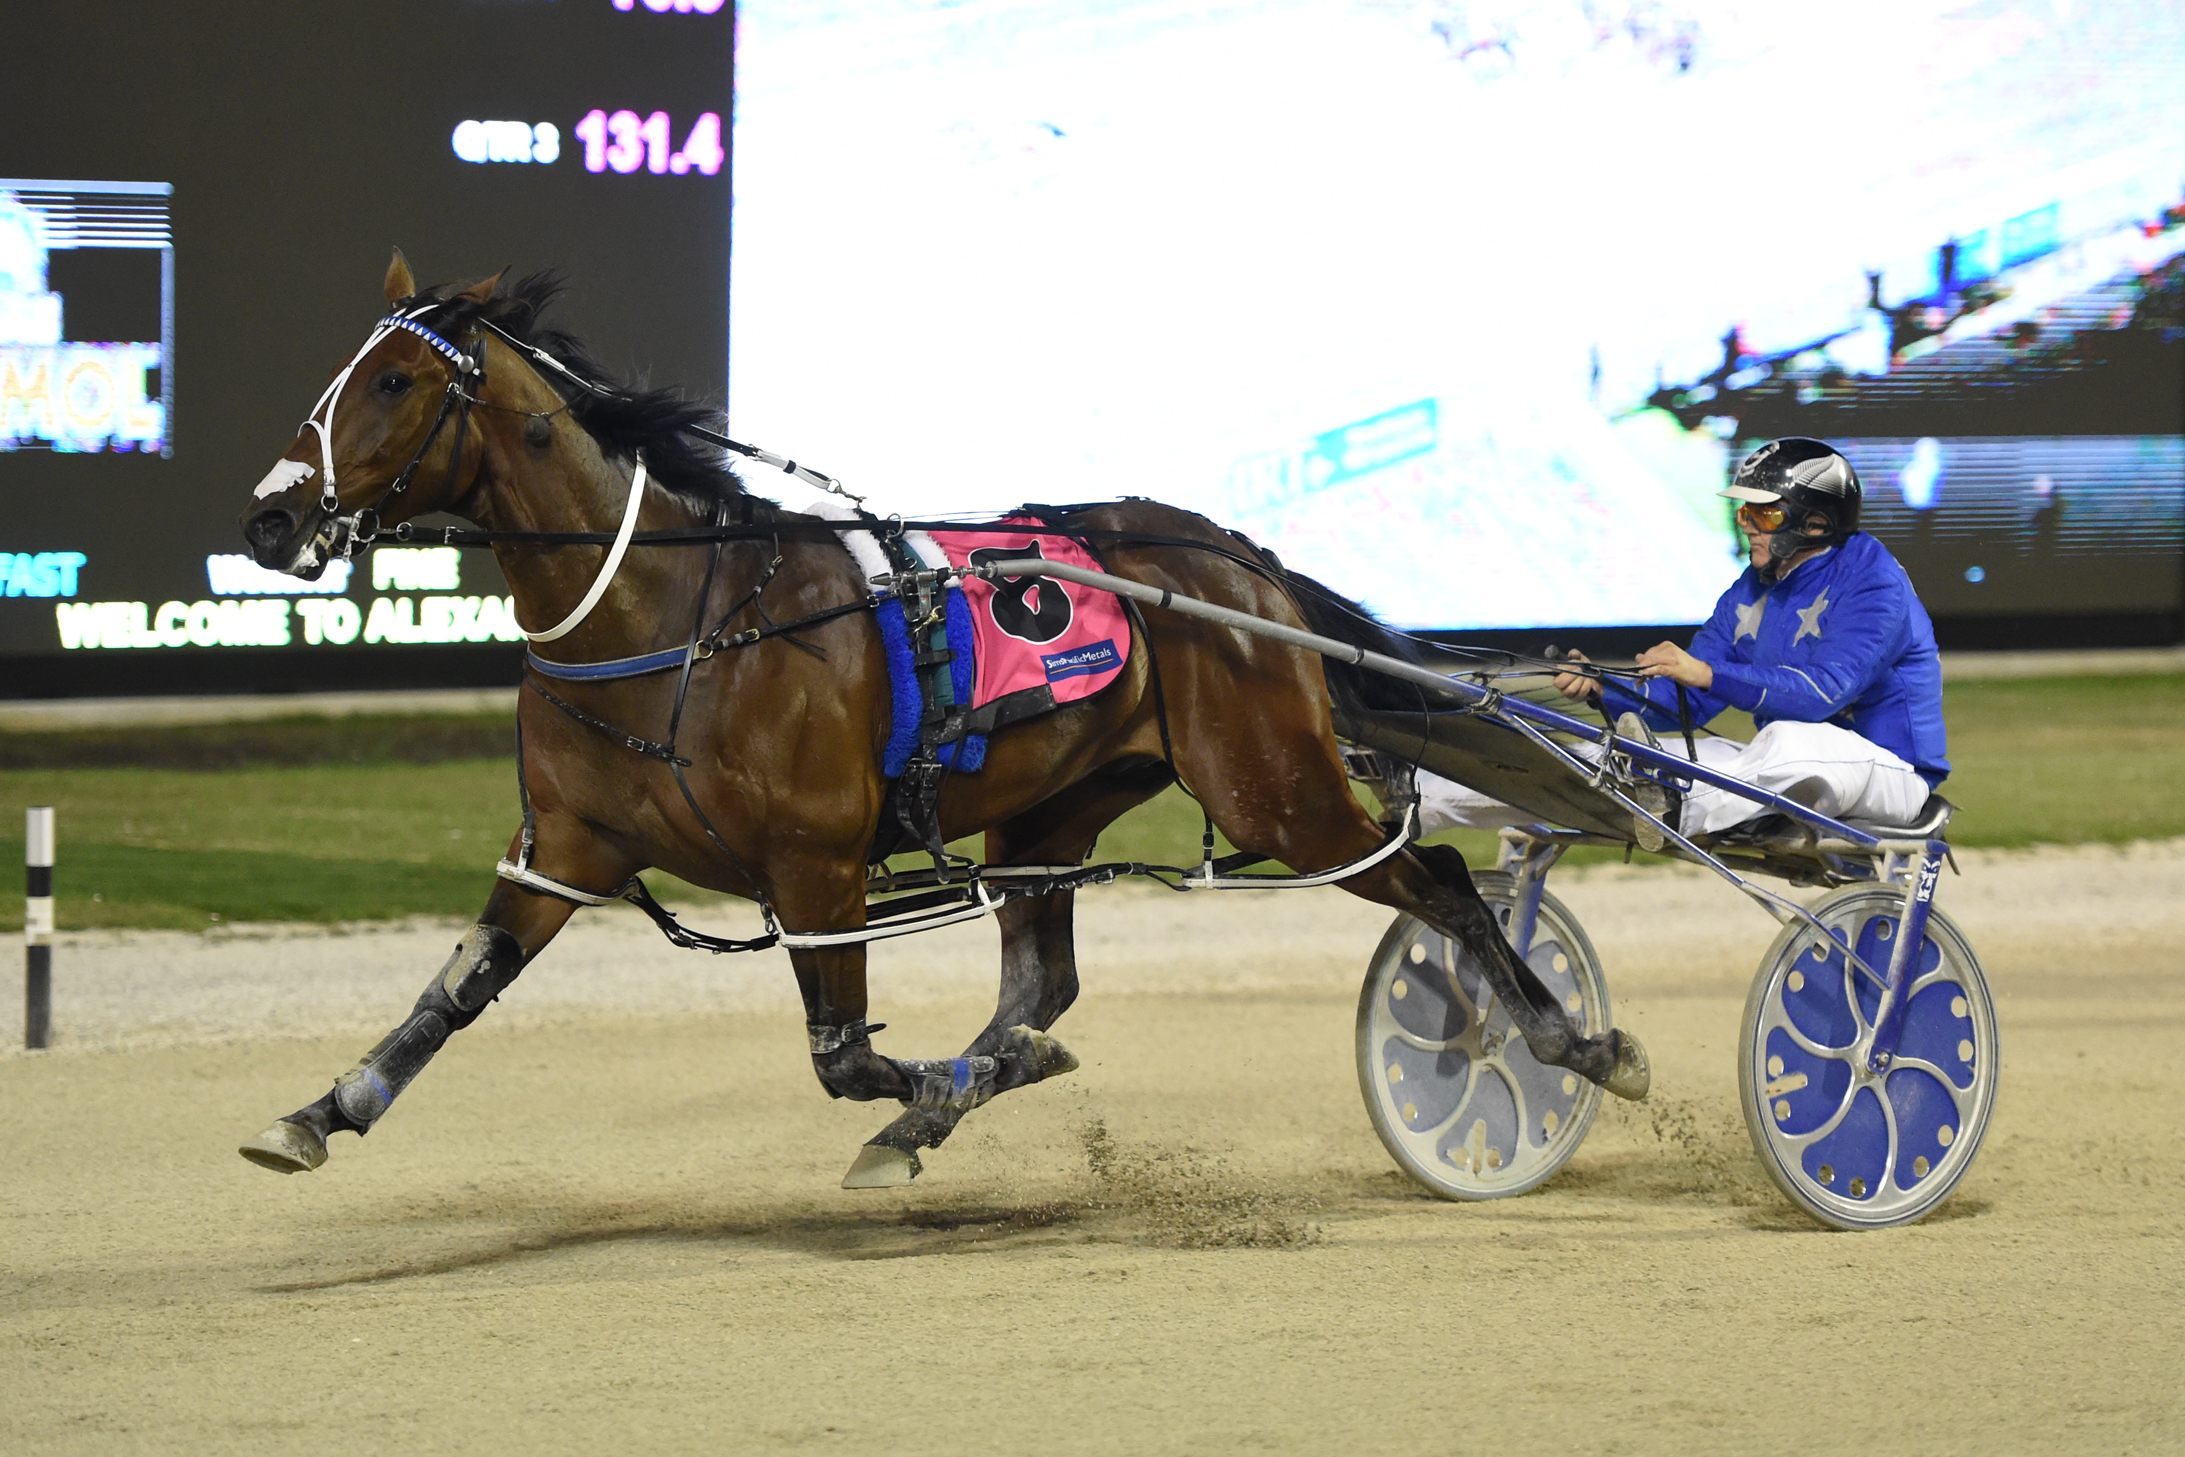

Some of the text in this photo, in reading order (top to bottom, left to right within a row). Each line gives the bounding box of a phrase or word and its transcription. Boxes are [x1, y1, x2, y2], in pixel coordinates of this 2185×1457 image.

[574, 109, 724, 176] 131.4
[56, 599, 292, 649] WELCOME
[295, 598, 362, 645] TO
